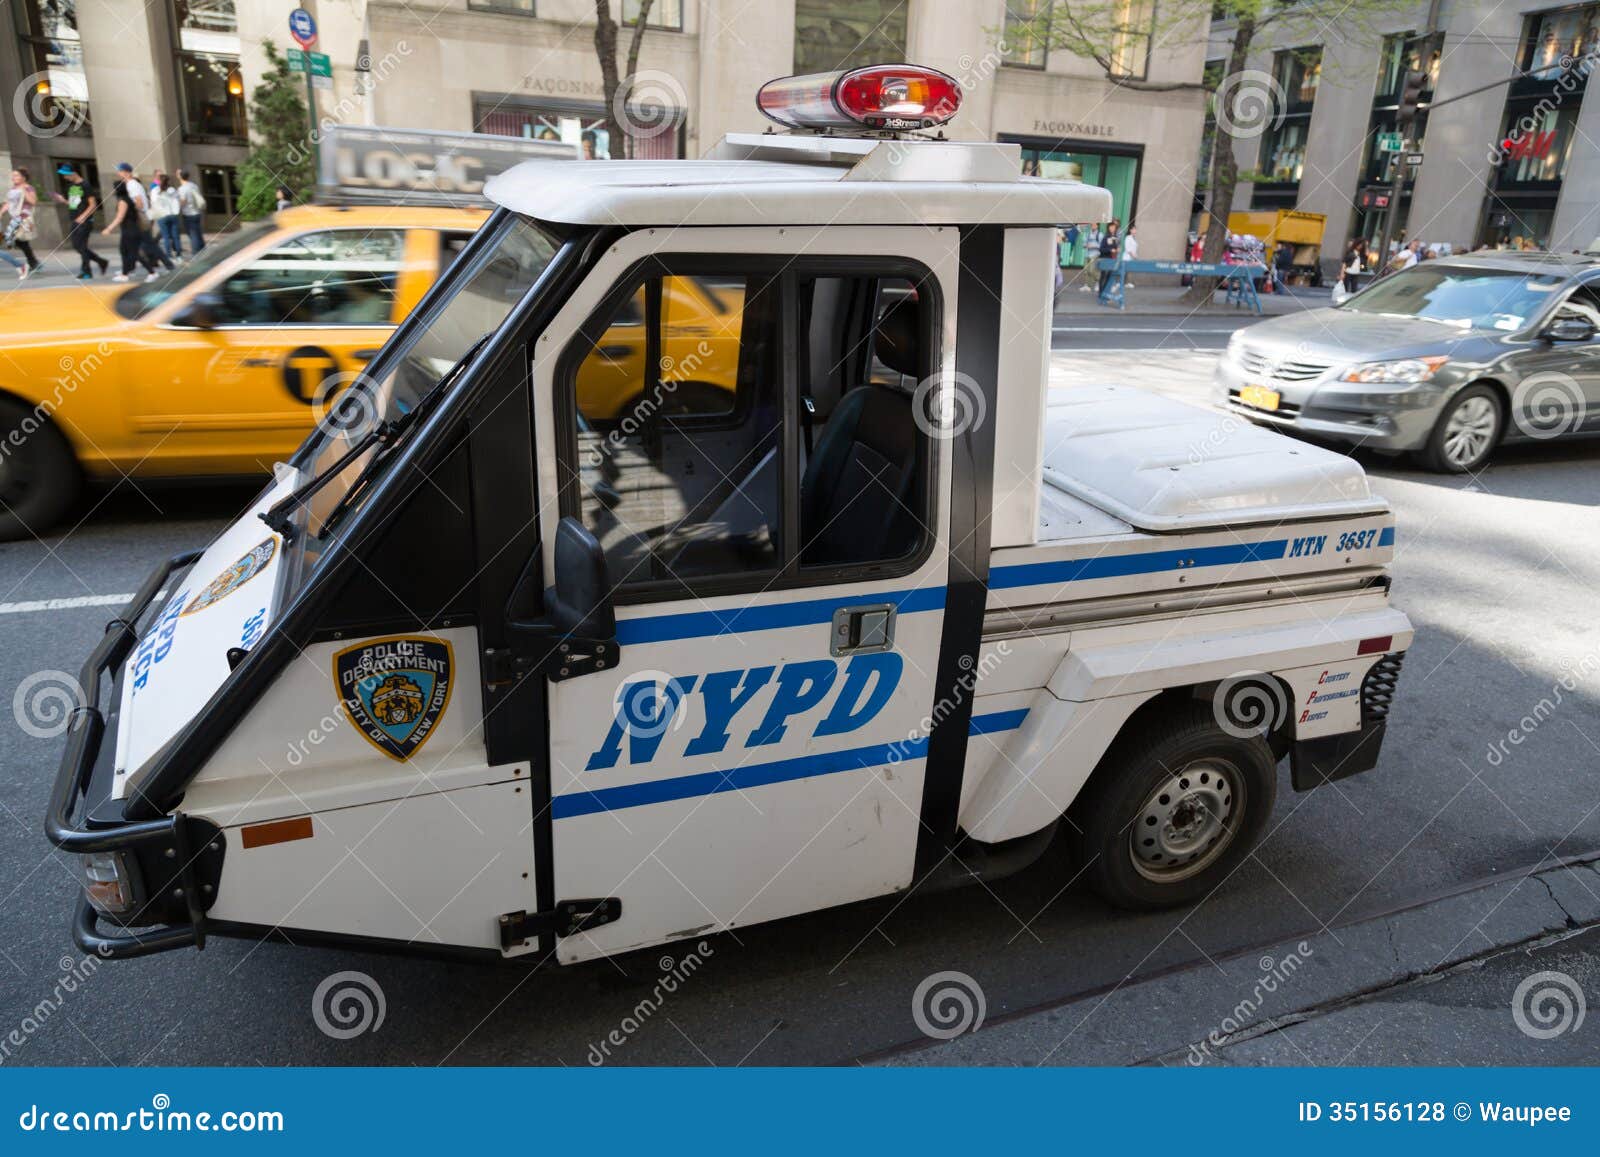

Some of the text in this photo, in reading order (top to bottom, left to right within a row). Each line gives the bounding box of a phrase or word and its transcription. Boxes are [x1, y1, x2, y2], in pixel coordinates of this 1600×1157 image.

[1288, 535, 1328, 558] MTN
[1336, 529, 1377, 553] 3687
[362, 641, 425, 658] POLICE
[343, 655, 447, 687] DEPARTMENT
[346, 698, 389, 743] CITY OF
[409, 680, 448, 745] NEW YORK
[584, 652, 904, 771] NYPD
